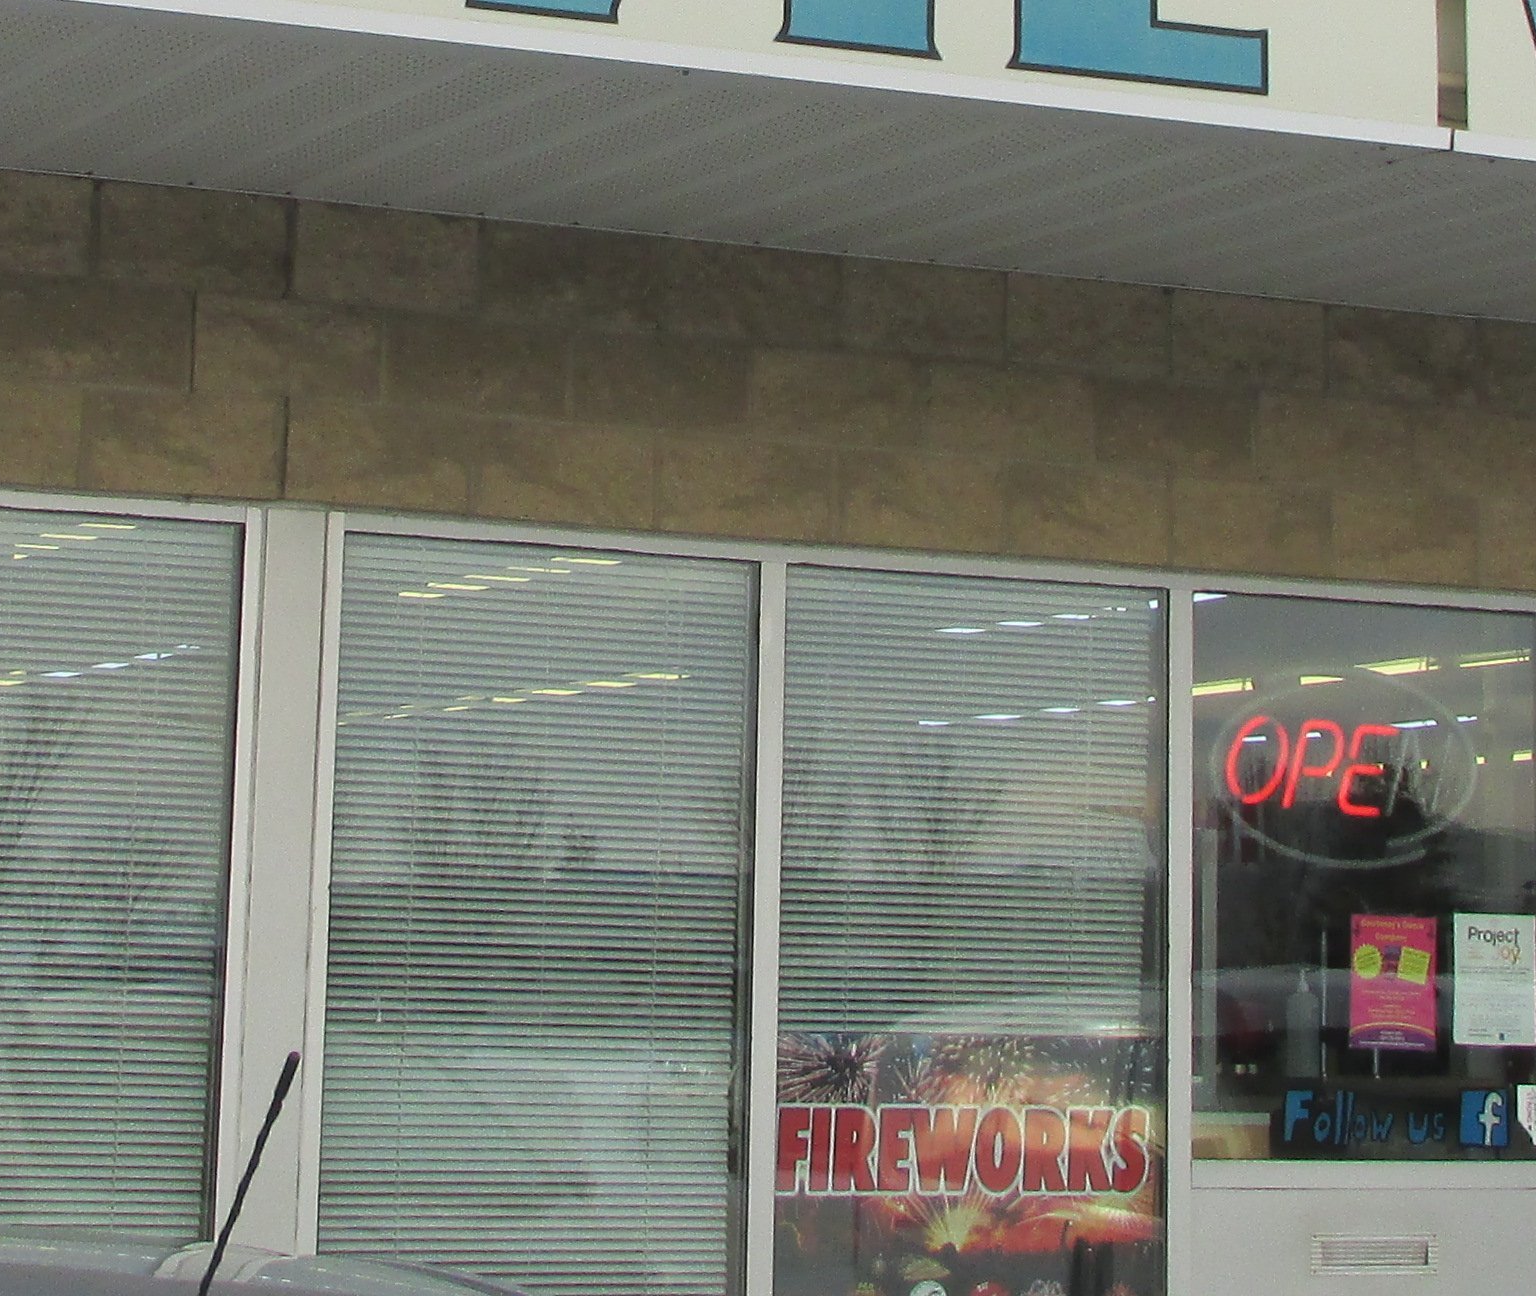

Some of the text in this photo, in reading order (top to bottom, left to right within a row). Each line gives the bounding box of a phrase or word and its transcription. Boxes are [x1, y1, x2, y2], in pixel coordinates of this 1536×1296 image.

[1468, 926, 1520, 946] Project
[1284, 1090, 1394, 1145] Follow
[776, 1105, 1150, 1196] FIREWORKS
